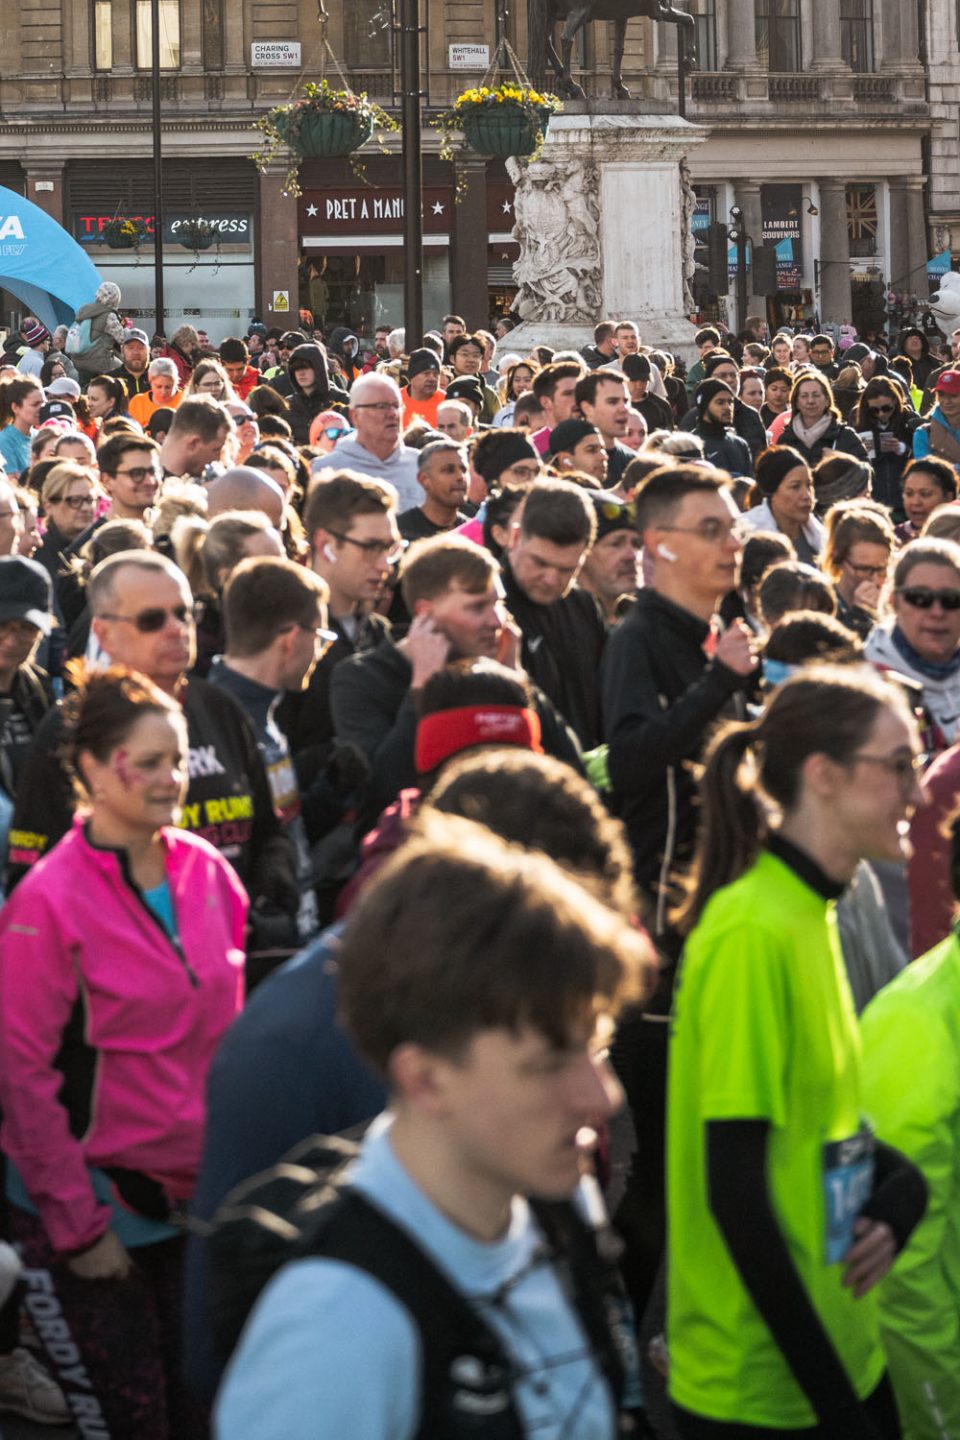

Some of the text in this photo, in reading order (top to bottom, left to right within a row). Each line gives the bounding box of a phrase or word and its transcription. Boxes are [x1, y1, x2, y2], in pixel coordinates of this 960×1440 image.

[326, 198, 424, 219] PRET A MAN
[763, 220, 798, 229] LAMBERT
[761, 230, 800, 239] SOUVENIRS
[2, 244, 26, 256] FLY
[18, 1268, 93, 1390] FORDY
